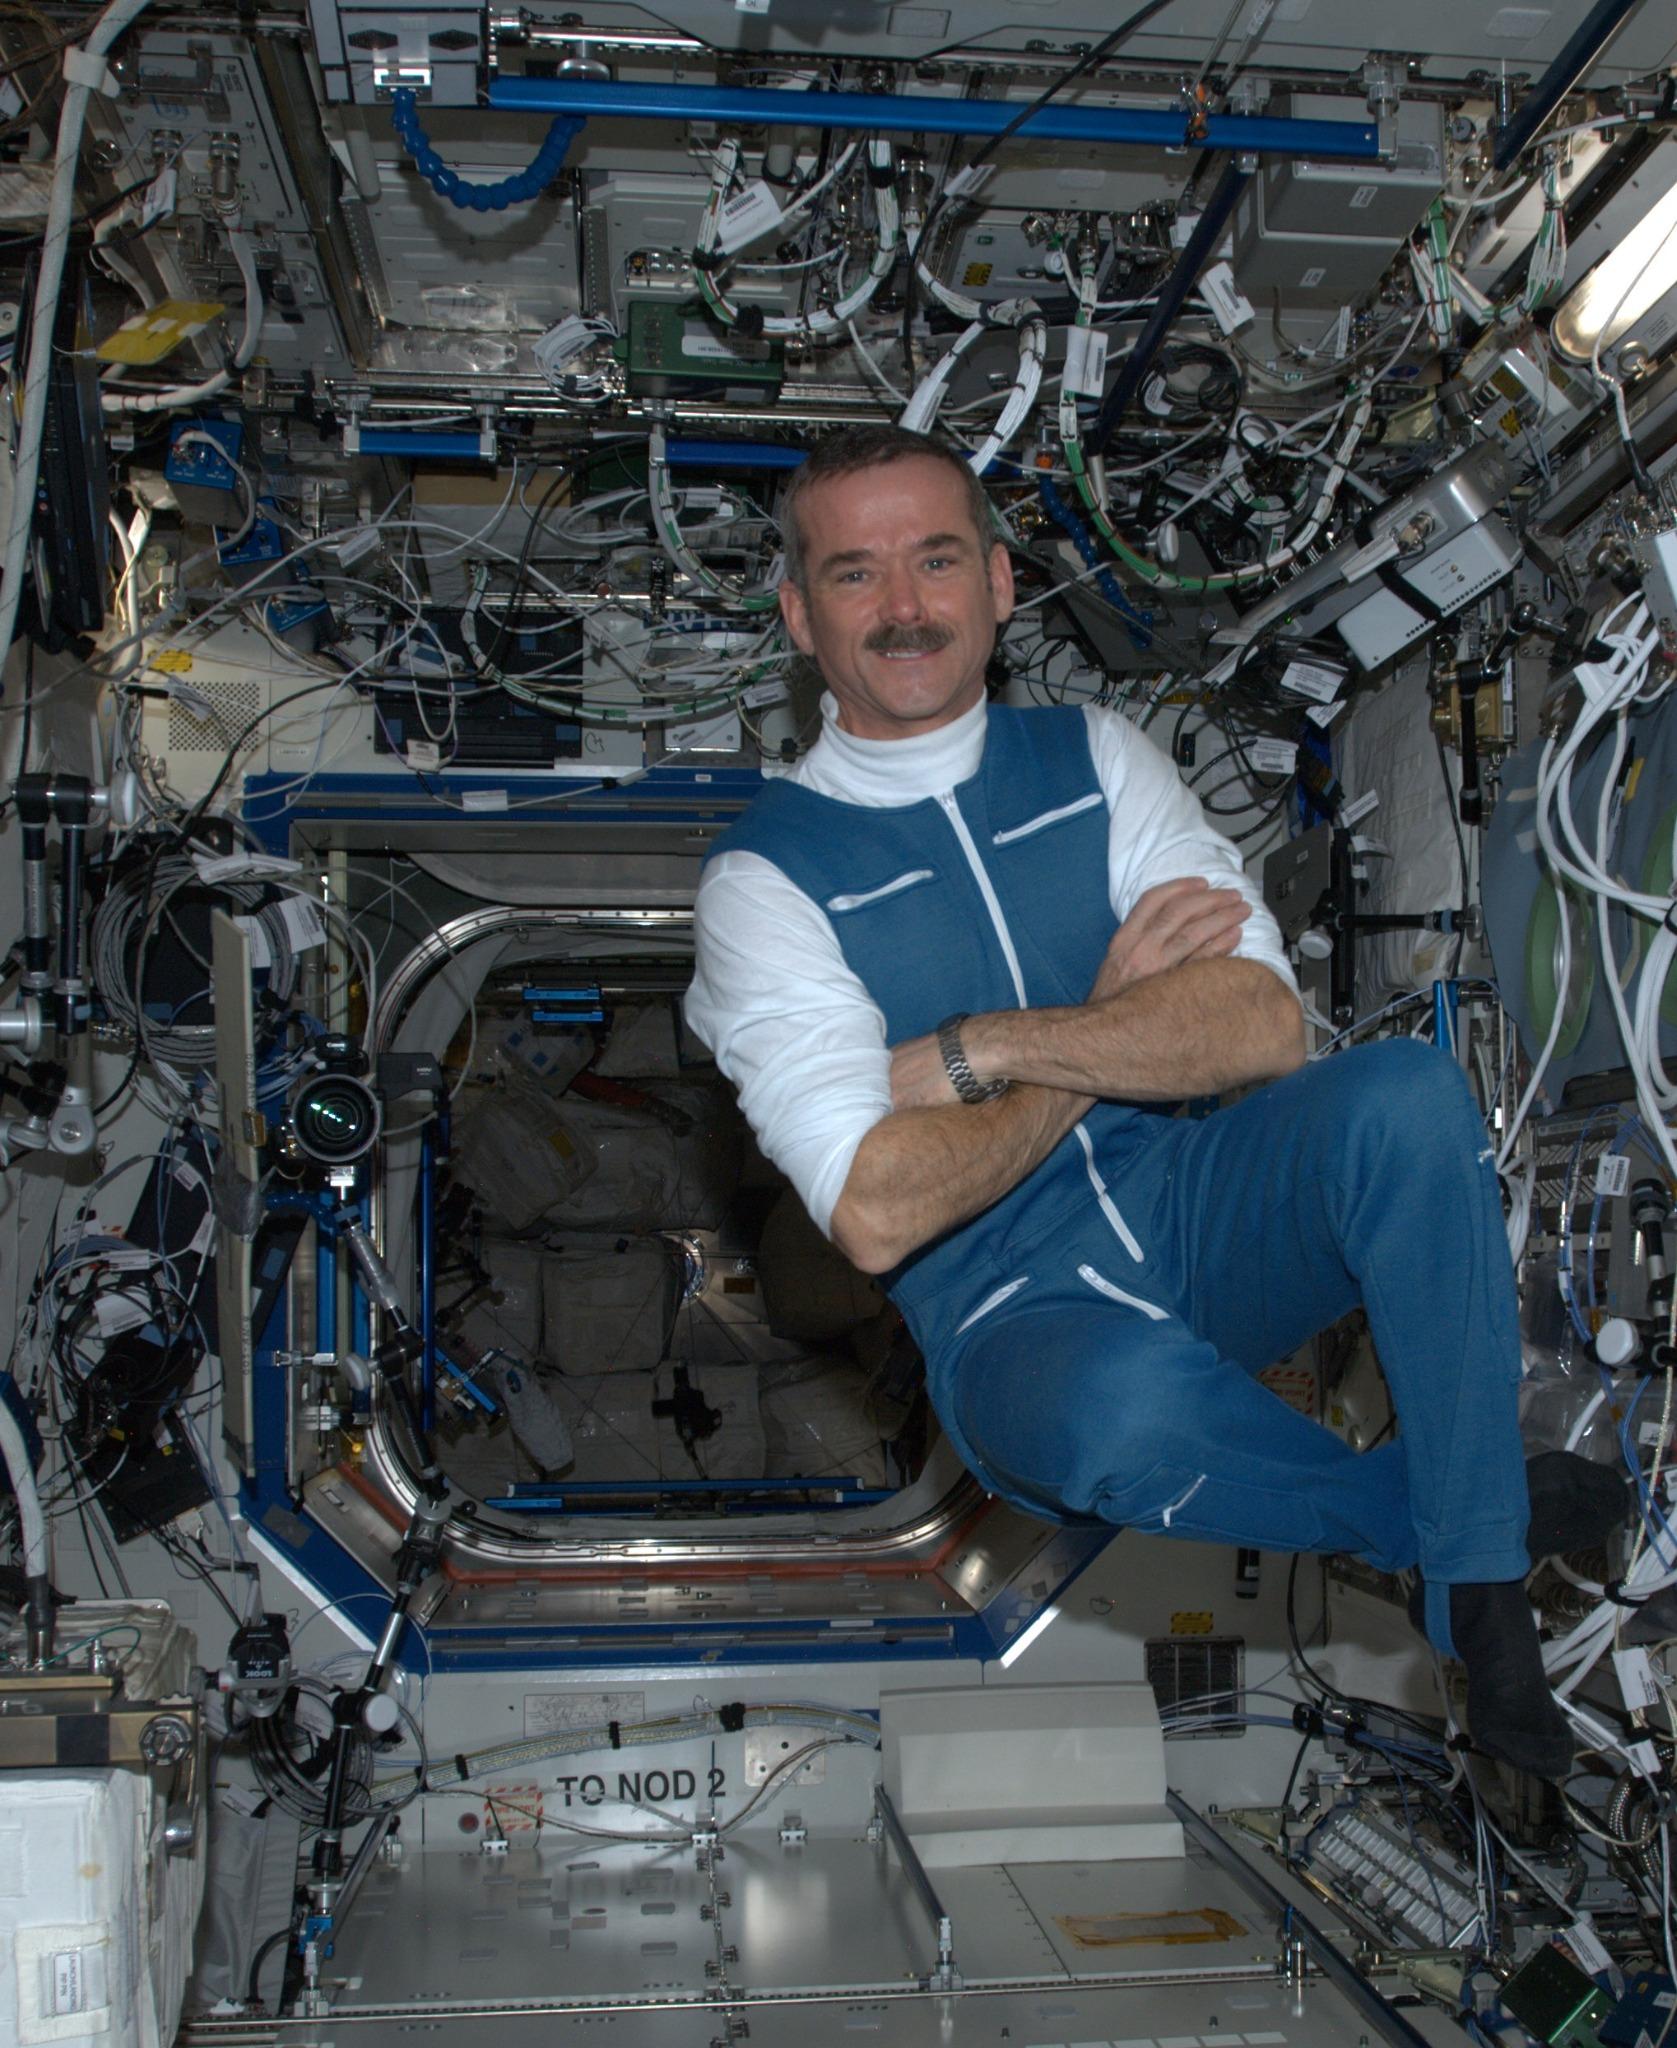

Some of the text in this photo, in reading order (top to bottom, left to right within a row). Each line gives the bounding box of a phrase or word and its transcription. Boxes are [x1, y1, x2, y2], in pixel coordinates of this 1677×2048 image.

[556, 1767, 726, 1806] TO NOD 2
